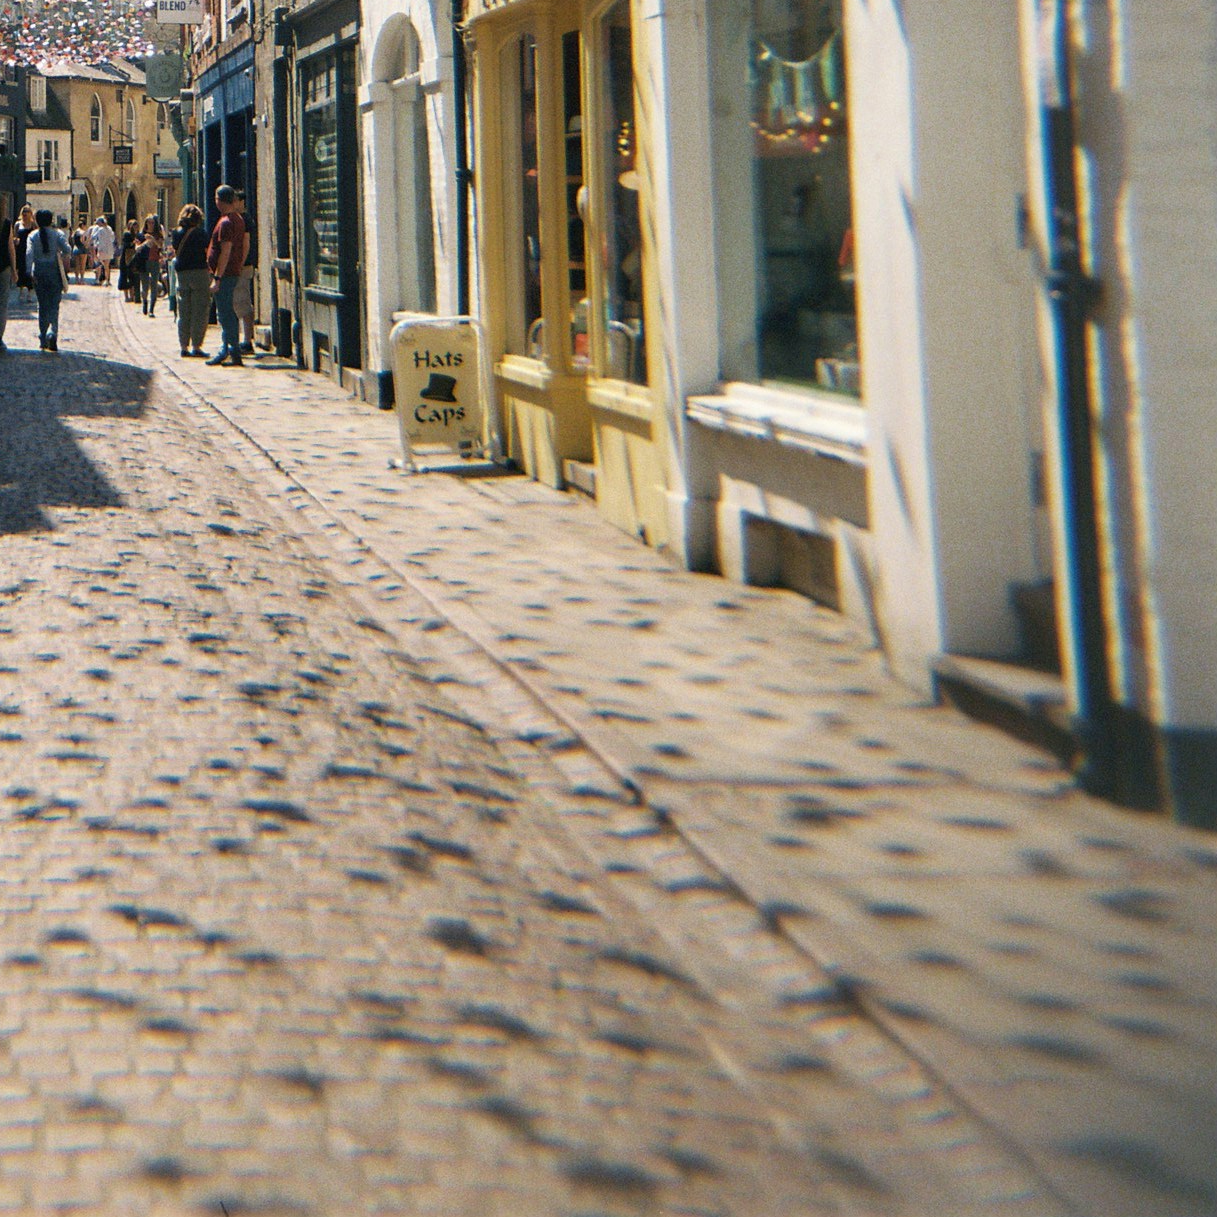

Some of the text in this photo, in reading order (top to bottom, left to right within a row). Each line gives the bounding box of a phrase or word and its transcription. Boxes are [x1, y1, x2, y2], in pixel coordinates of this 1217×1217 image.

[159, 1, 186, 11] BLEND
[413, 350, 464, 368] Hats
[414, 404, 466, 426] Caps
